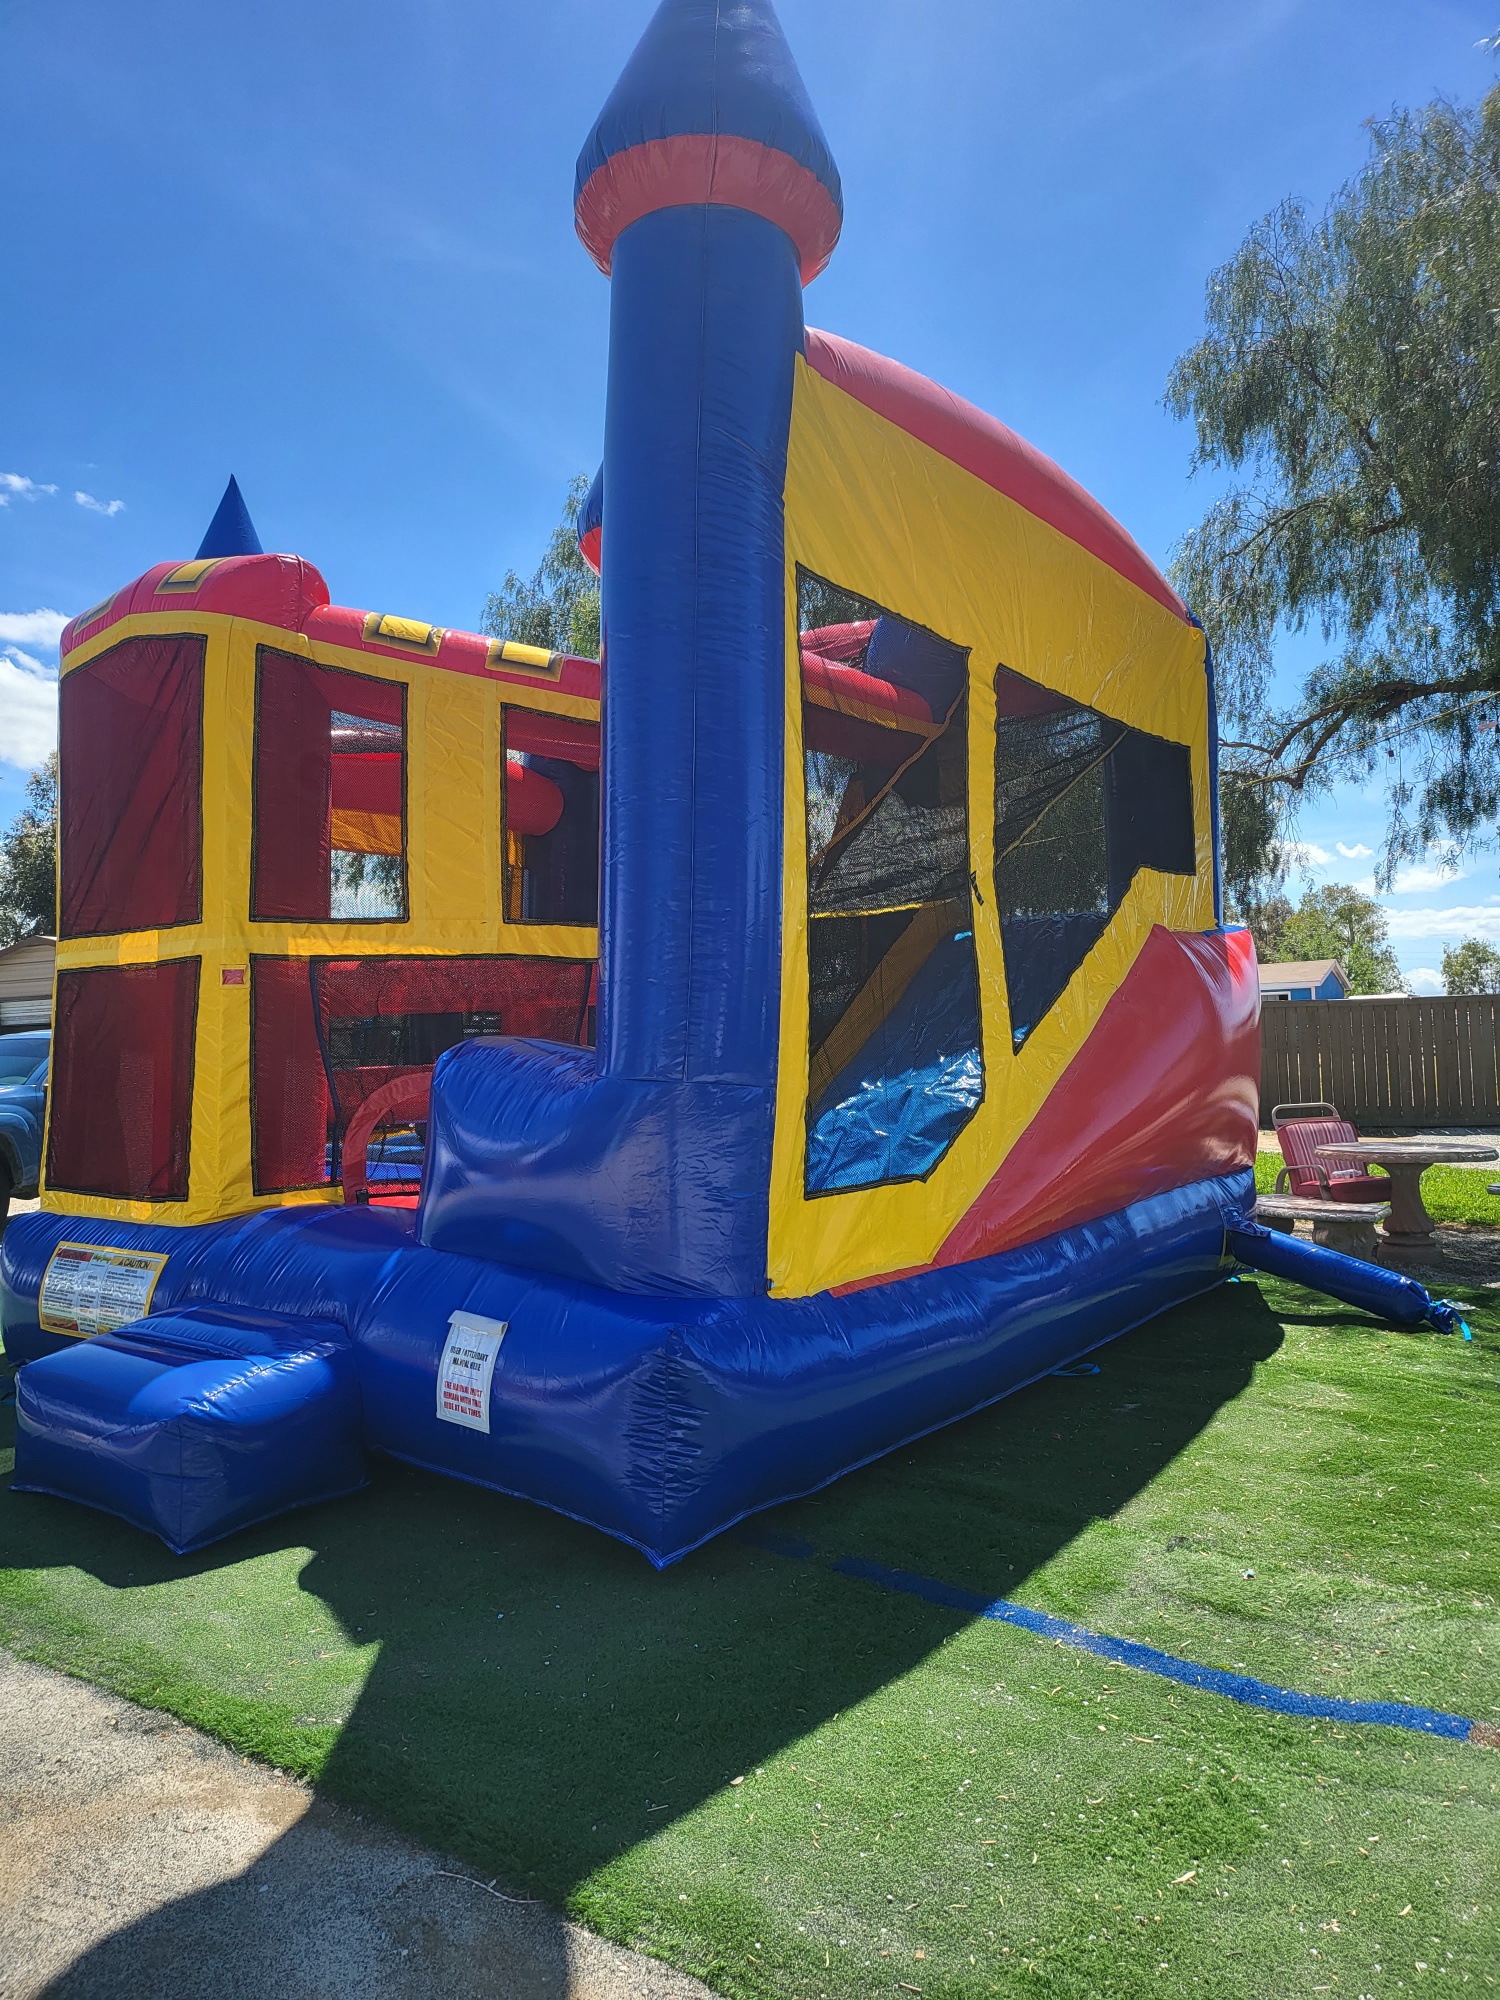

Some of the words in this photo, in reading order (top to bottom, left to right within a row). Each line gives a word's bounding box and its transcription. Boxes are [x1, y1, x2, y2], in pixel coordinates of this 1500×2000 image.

[123, 1258, 151, 1270] CAUTION
[444, 1381, 452, 1390] THE
[443, 1391, 460, 1402] REMAIN
[460, 1395, 472, 1406] WITH
[454, 1404, 460, 1412] AT
[468, 1408, 482, 1419] TIMES
